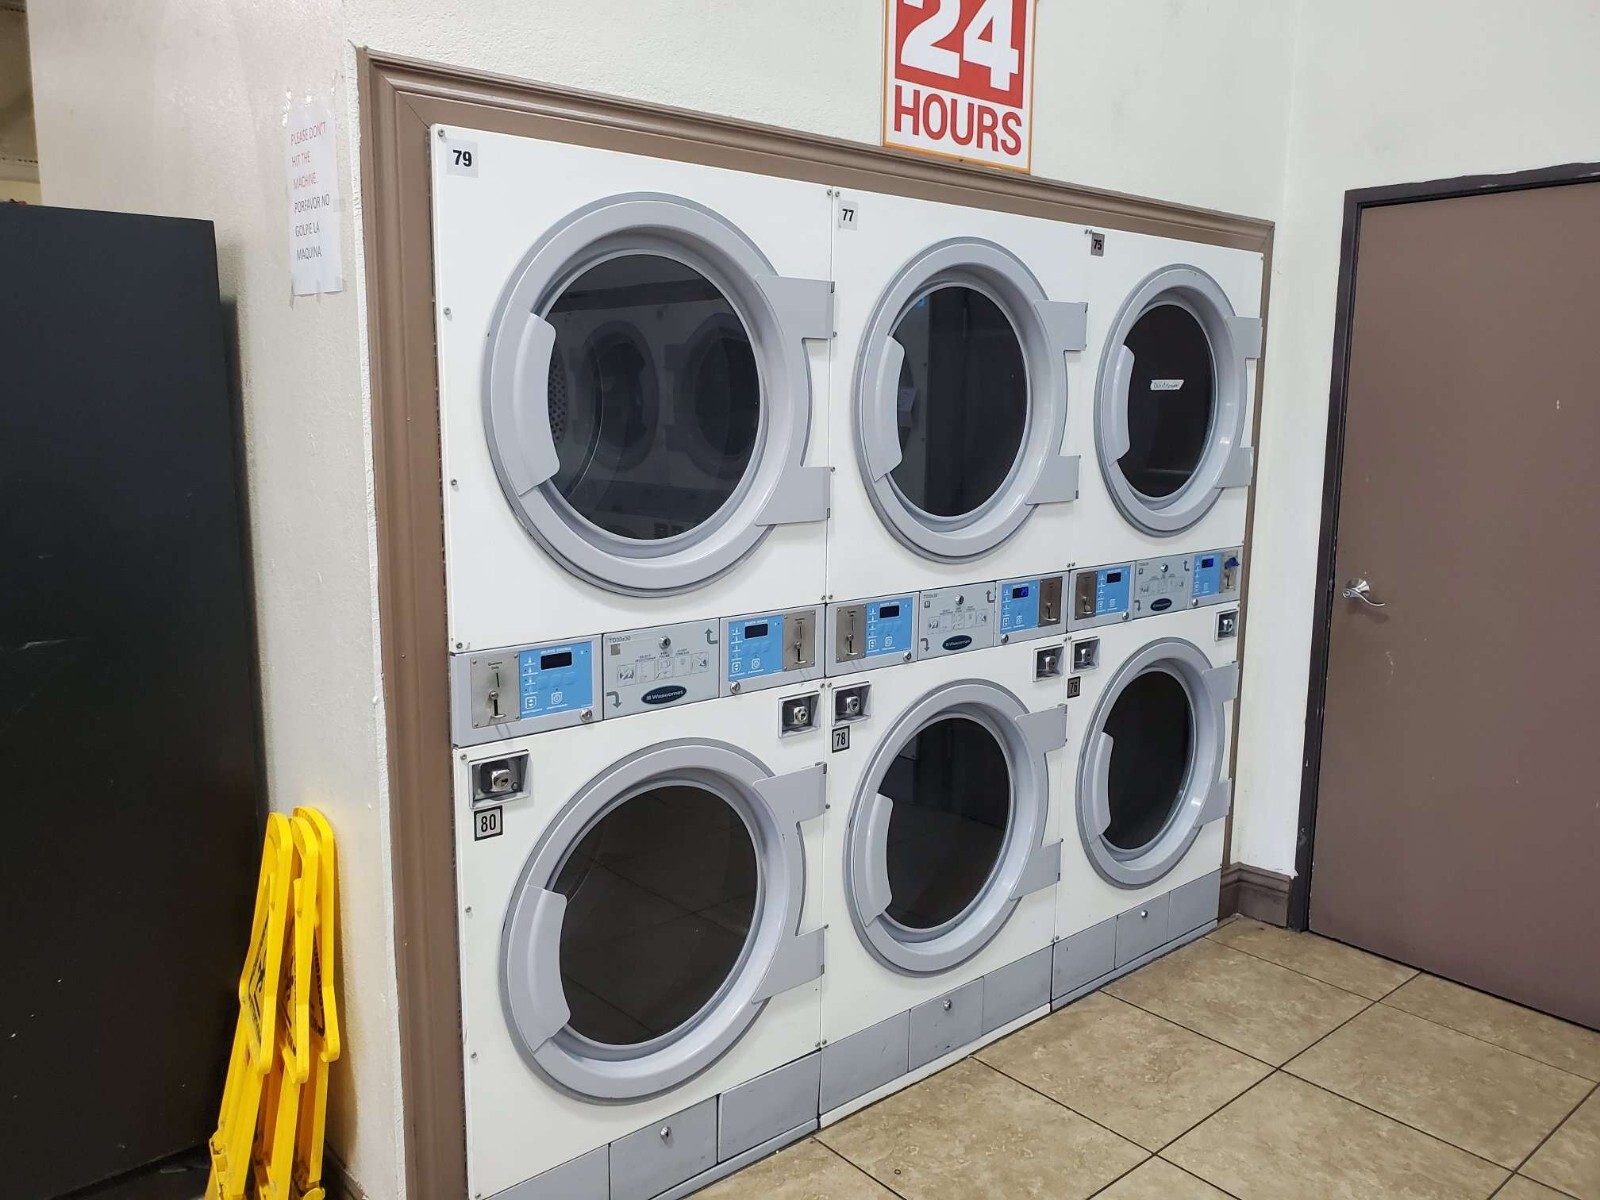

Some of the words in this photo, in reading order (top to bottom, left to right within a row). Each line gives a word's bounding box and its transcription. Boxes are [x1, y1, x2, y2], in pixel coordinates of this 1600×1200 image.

[900, 0, 1019, 92] 24
[894, 84, 1022, 156] HOURS
[291, 129, 308, 146] PLEASE
[291, 154, 301, 168] HIT
[301, 150, 311, 166] THE
[452, 149, 472, 167] 79
[321, 193, 329, 207] NO
[842, 208, 854, 222] 77
[313, 220, 321, 234] LA
[1093, 238, 1103, 251] 75
[297, 246, 322, 260] MAQUINA
[1069, 681, 1078, 694] 76
[835, 731, 846, 747] 78
[481, 813, 497, 833] 80
